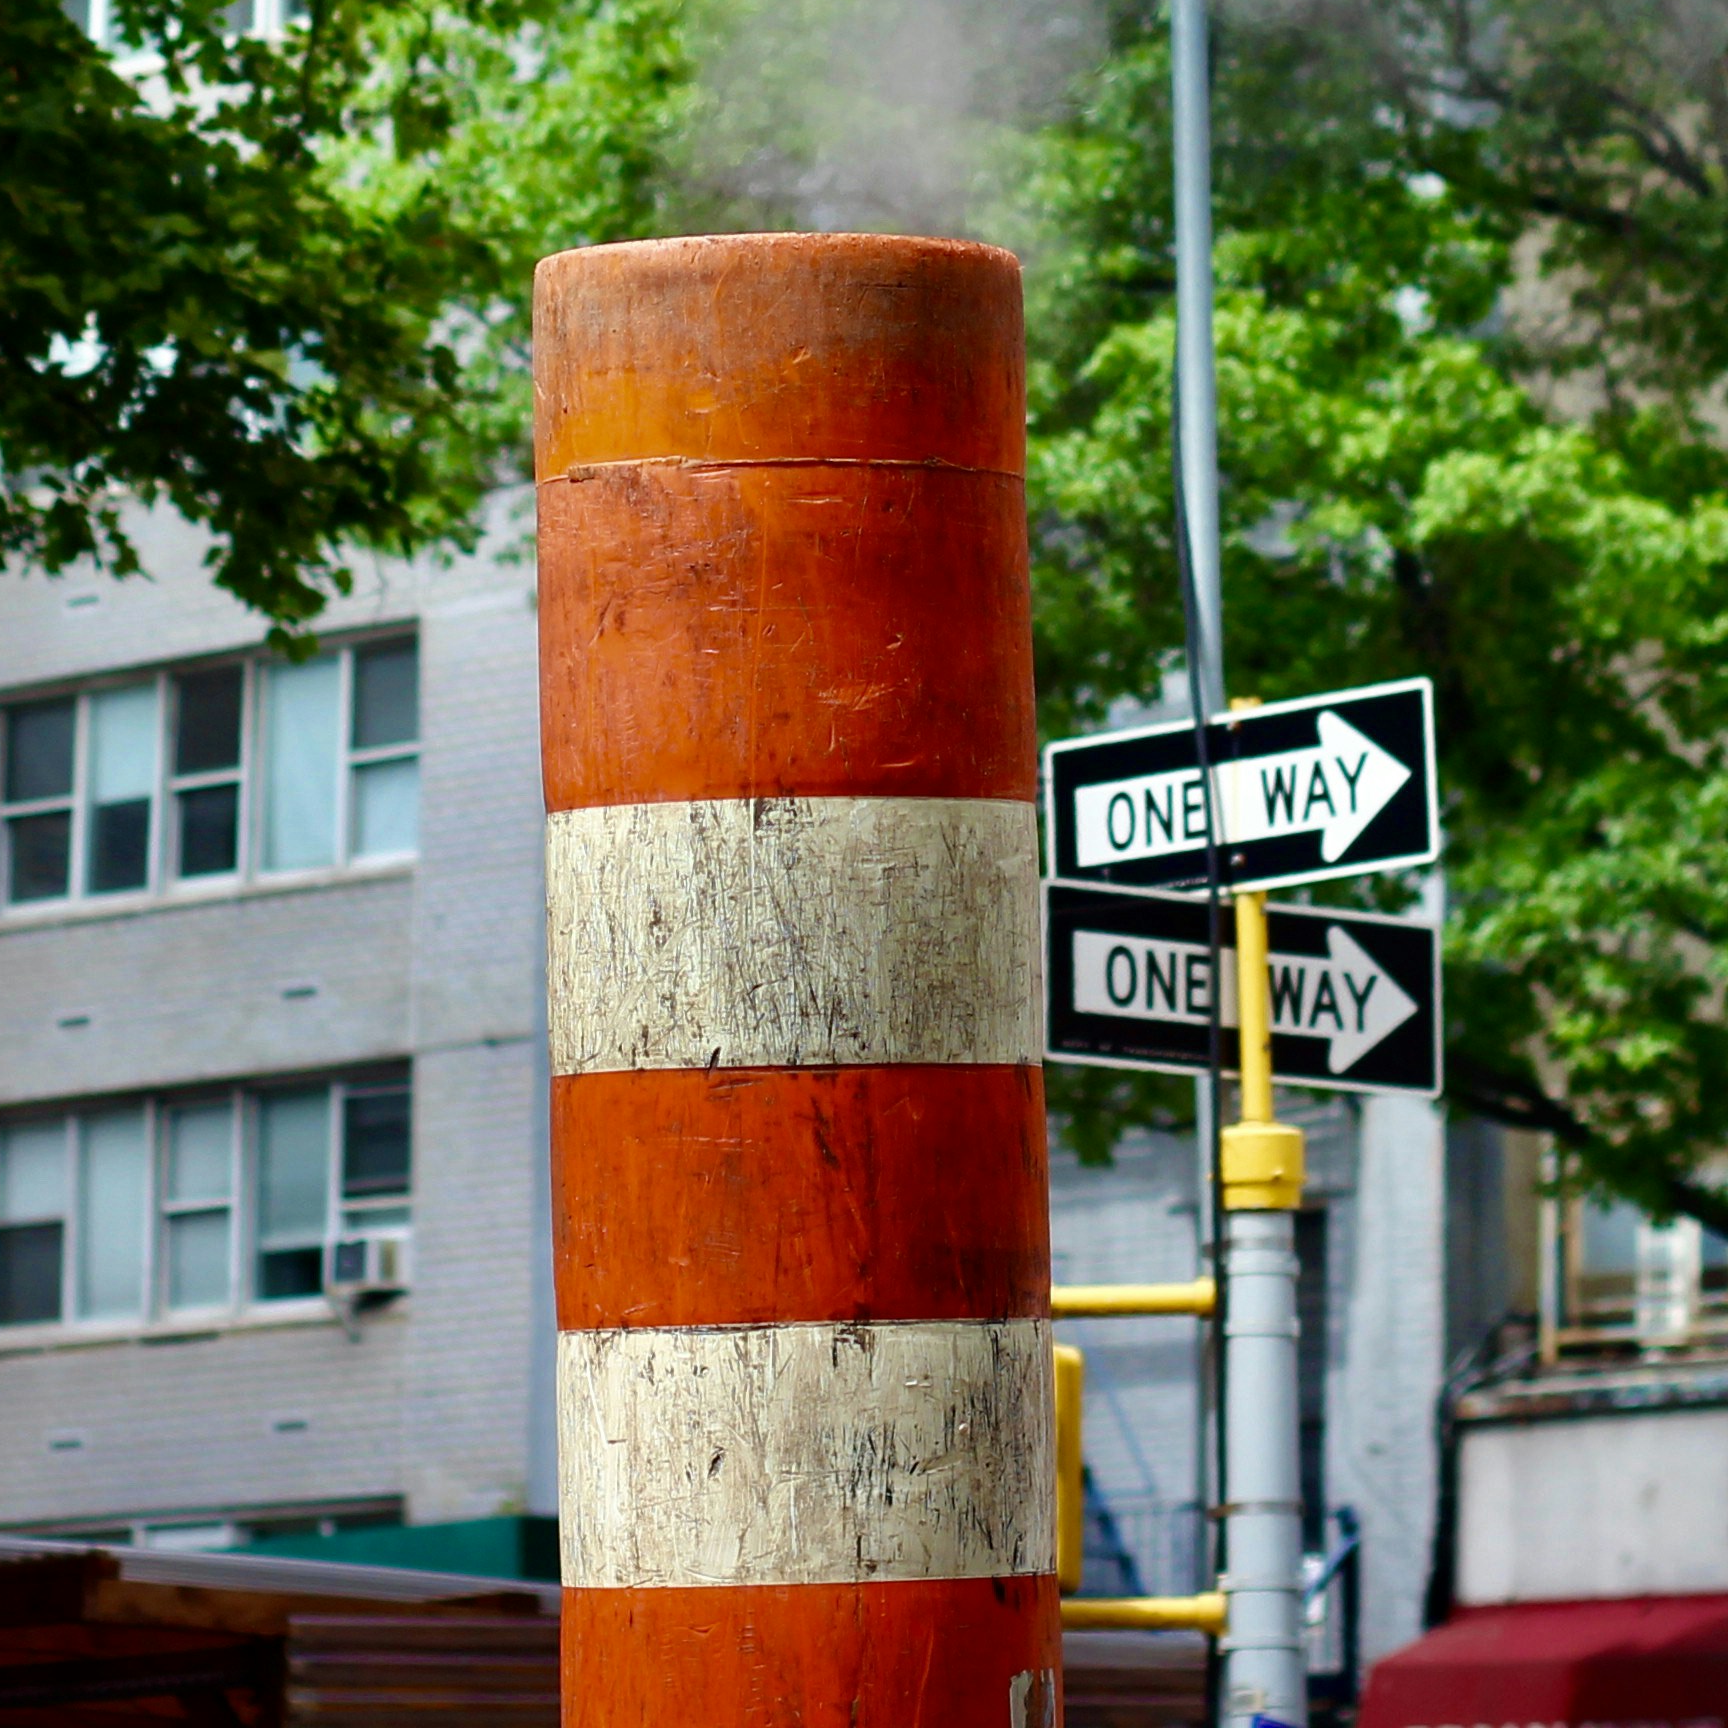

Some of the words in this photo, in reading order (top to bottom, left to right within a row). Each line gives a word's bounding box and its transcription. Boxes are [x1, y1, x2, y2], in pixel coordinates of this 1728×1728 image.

[1106, 779, 1209, 851] ONE
[1261, 751, 1369, 829] WAY
[1105, 945, 1212, 1015] ONE
[1269, 963, 1378, 1033] WAY
